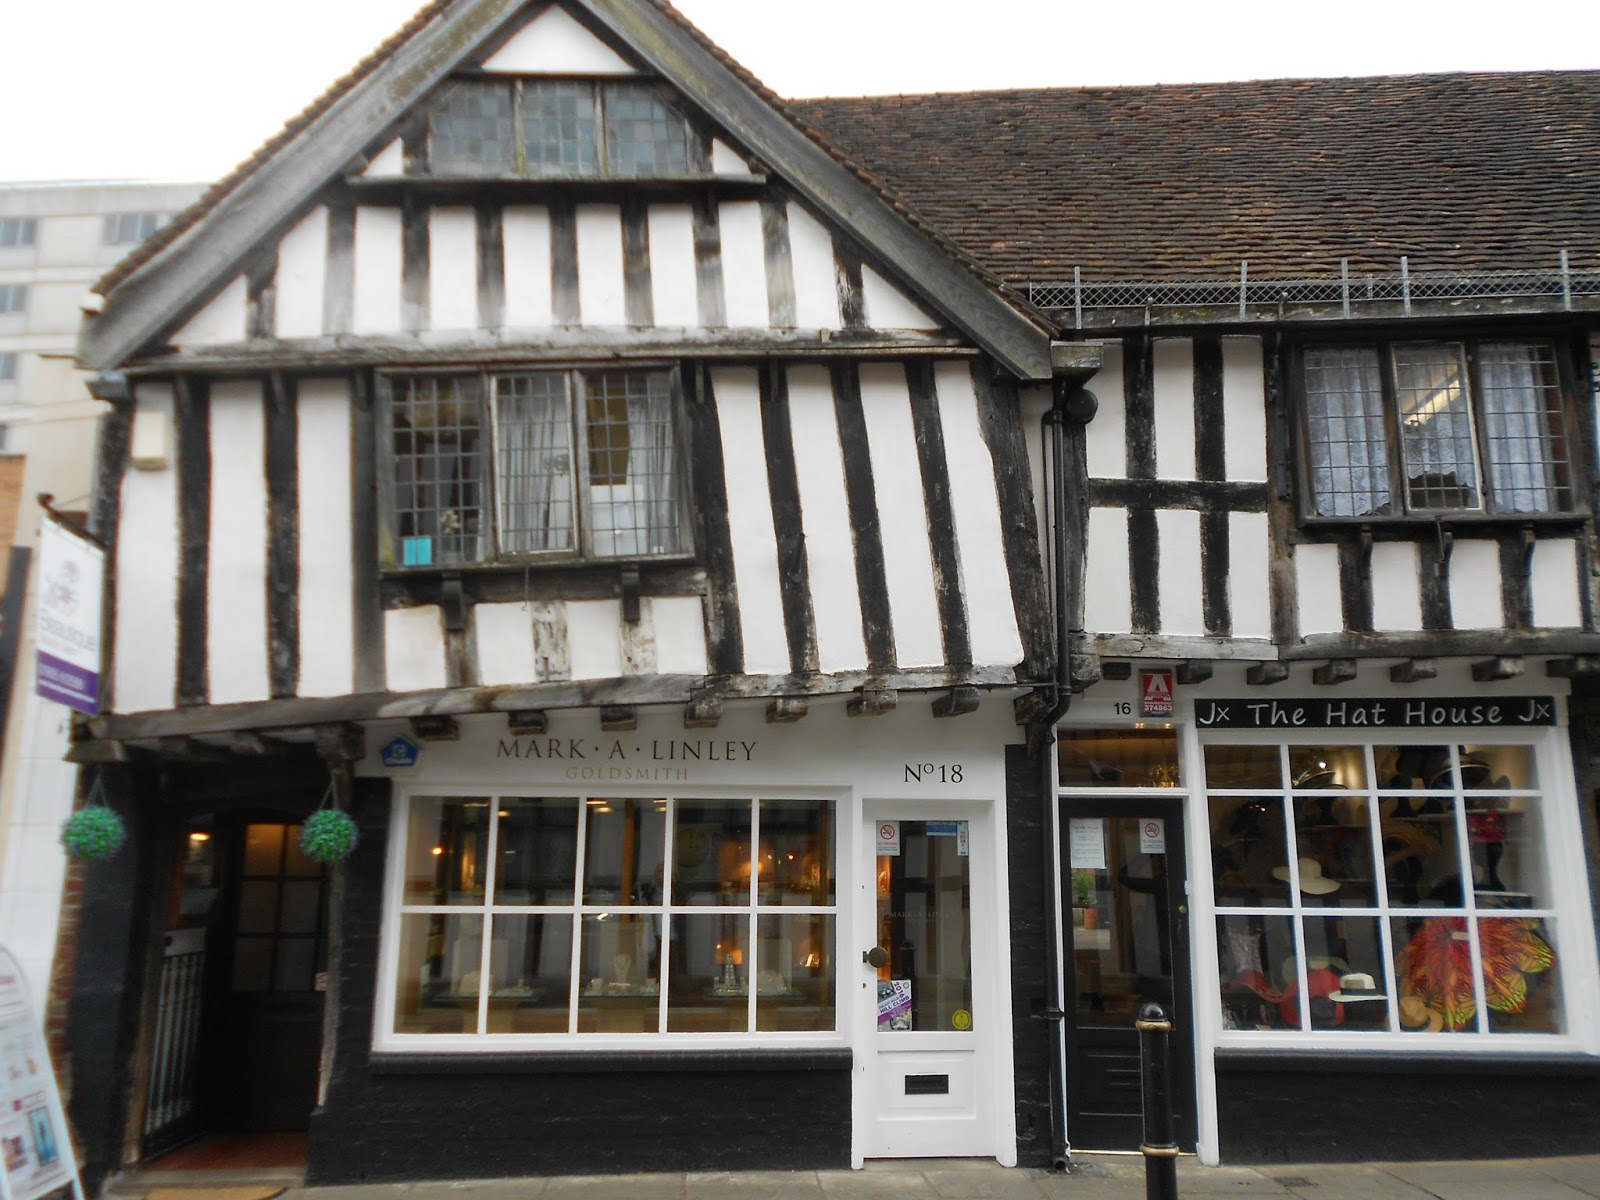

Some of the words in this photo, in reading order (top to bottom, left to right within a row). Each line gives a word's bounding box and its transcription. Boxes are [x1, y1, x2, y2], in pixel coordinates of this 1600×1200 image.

[1113, 702, 1132, 715] 16
[1247, 701, 1306, 725] The
[1325, 702, 1386, 725] Hat
[1405, 701, 1503, 725] House
[496, 738, 586, 759] MARK
[608, 739, 626, 759] A
[652, 740, 757, 761] LINLEY
[566, 766, 688, 780] GOLDSMITH
[894, 981, 906, 998] 2016
[880, 1004, 892, 1013] HILL
[893, 995, 910, 1007] CLIMB
